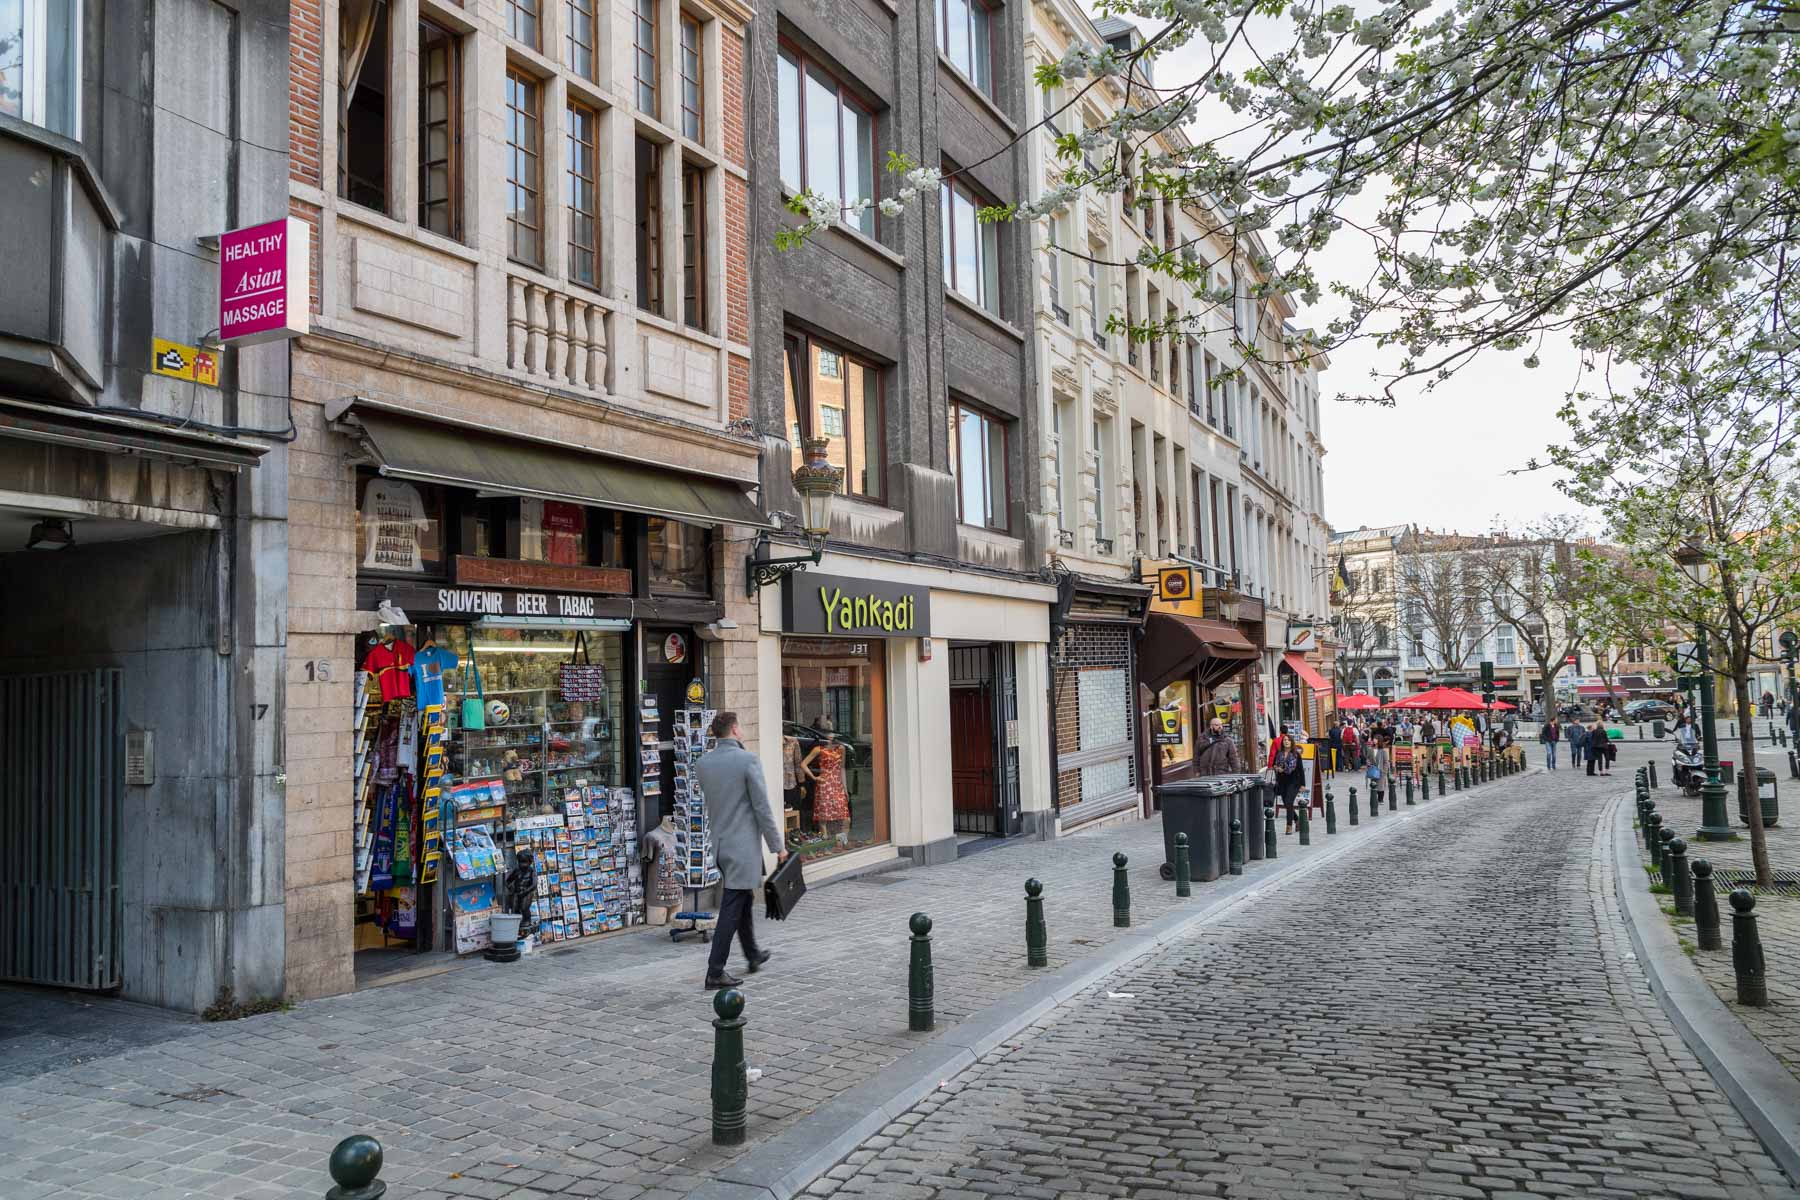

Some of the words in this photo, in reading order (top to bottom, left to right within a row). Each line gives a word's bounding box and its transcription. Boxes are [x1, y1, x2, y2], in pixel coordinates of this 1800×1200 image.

[225, 233, 283, 262] HEALTHY
[234, 267, 282, 294] Asian
[223, 298, 284, 326] MASSAGE
[438, 589, 503, 613] SOUVENIR
[516, 593, 548, 615] BEER
[557, 595, 595, 617] TABAC
[820, 586, 914, 633] Yankadi
[304, 659, 329, 682] 15
[249, 703, 269, 720] 17
